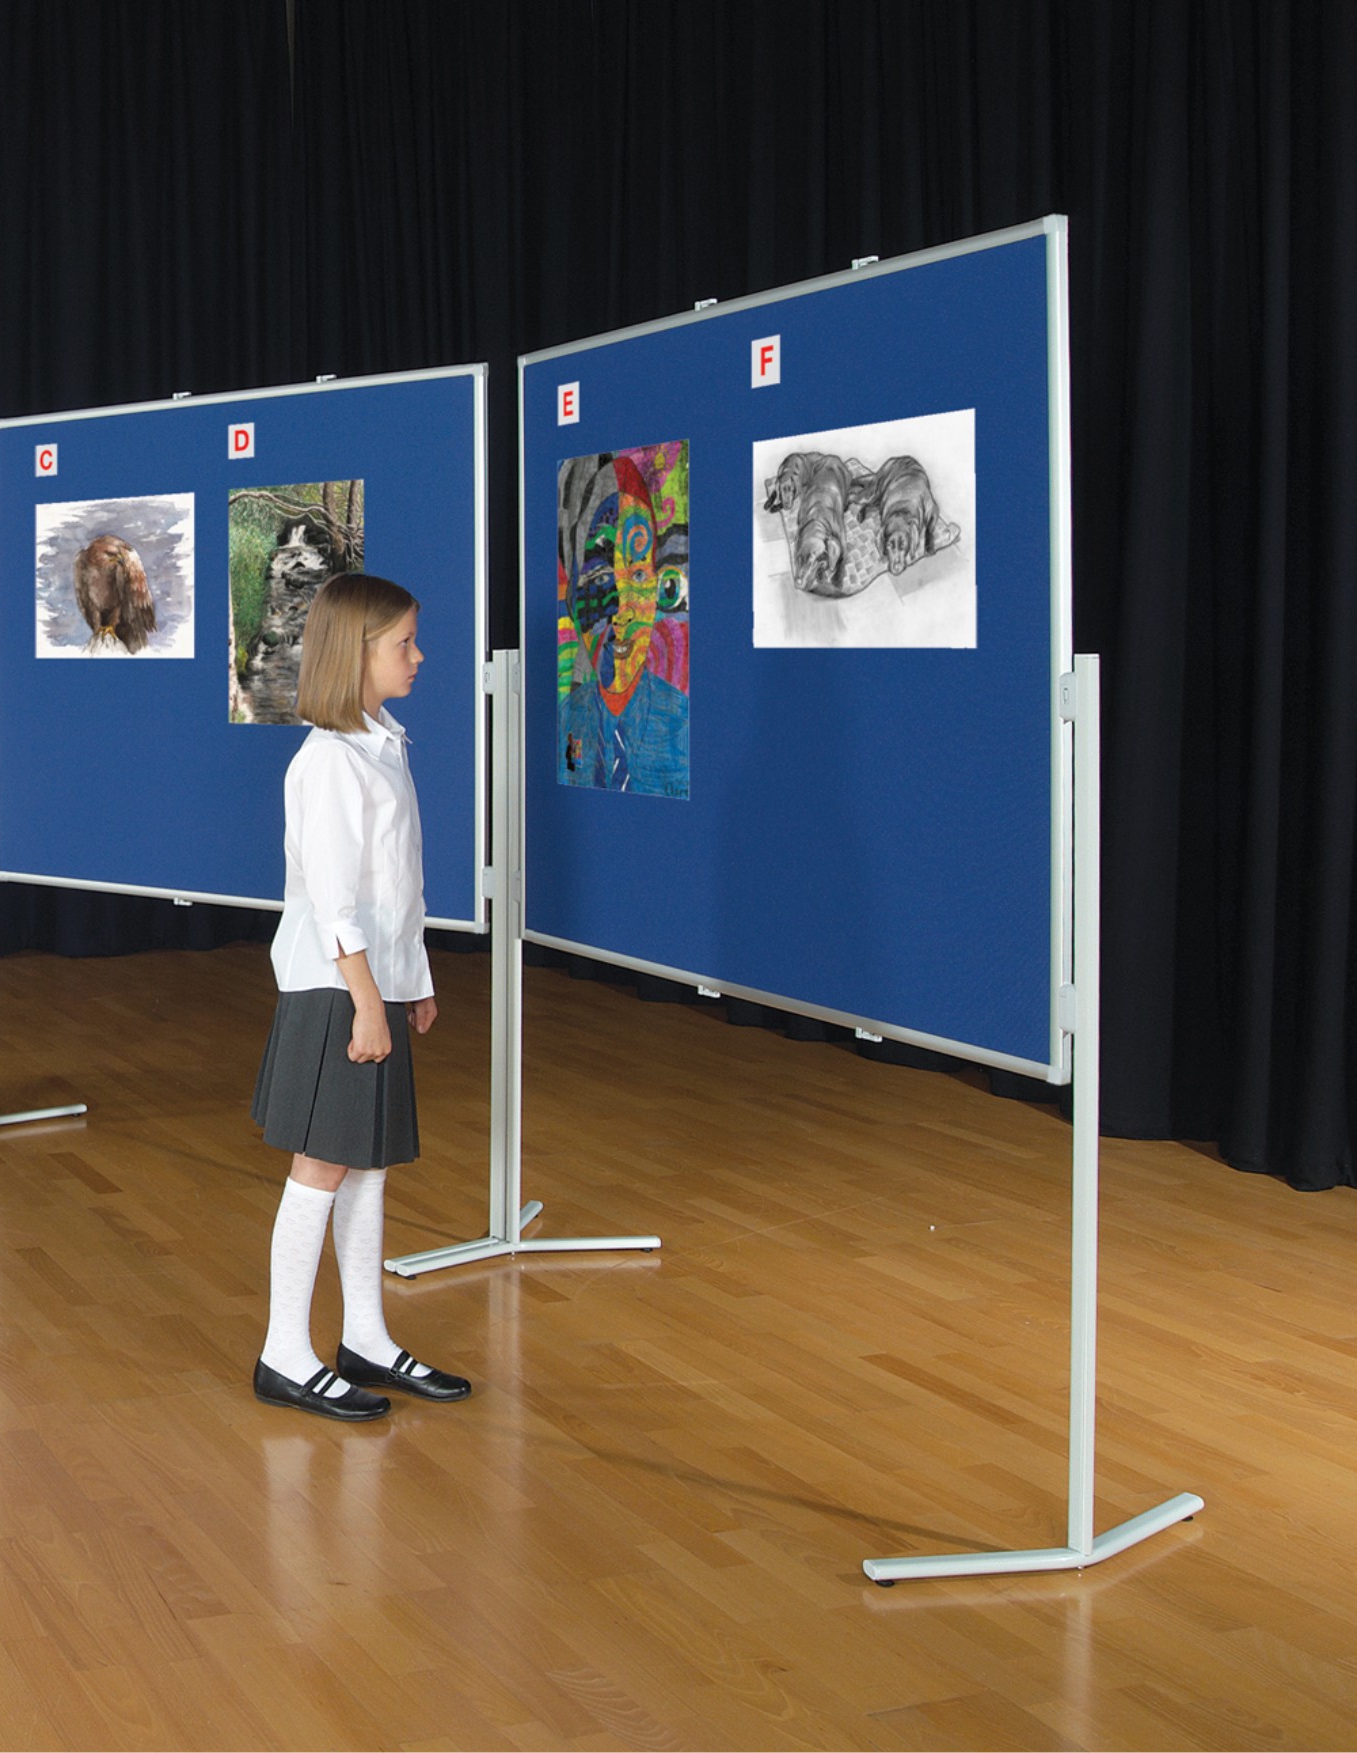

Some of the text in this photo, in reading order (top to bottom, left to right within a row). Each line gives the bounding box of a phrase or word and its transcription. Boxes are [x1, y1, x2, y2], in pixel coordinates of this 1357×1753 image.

[759, 344, 775, 377] F
[562, 389, 574, 417] E
[233, 428, 251, 454] D
[38, 449, 54, 471] C
